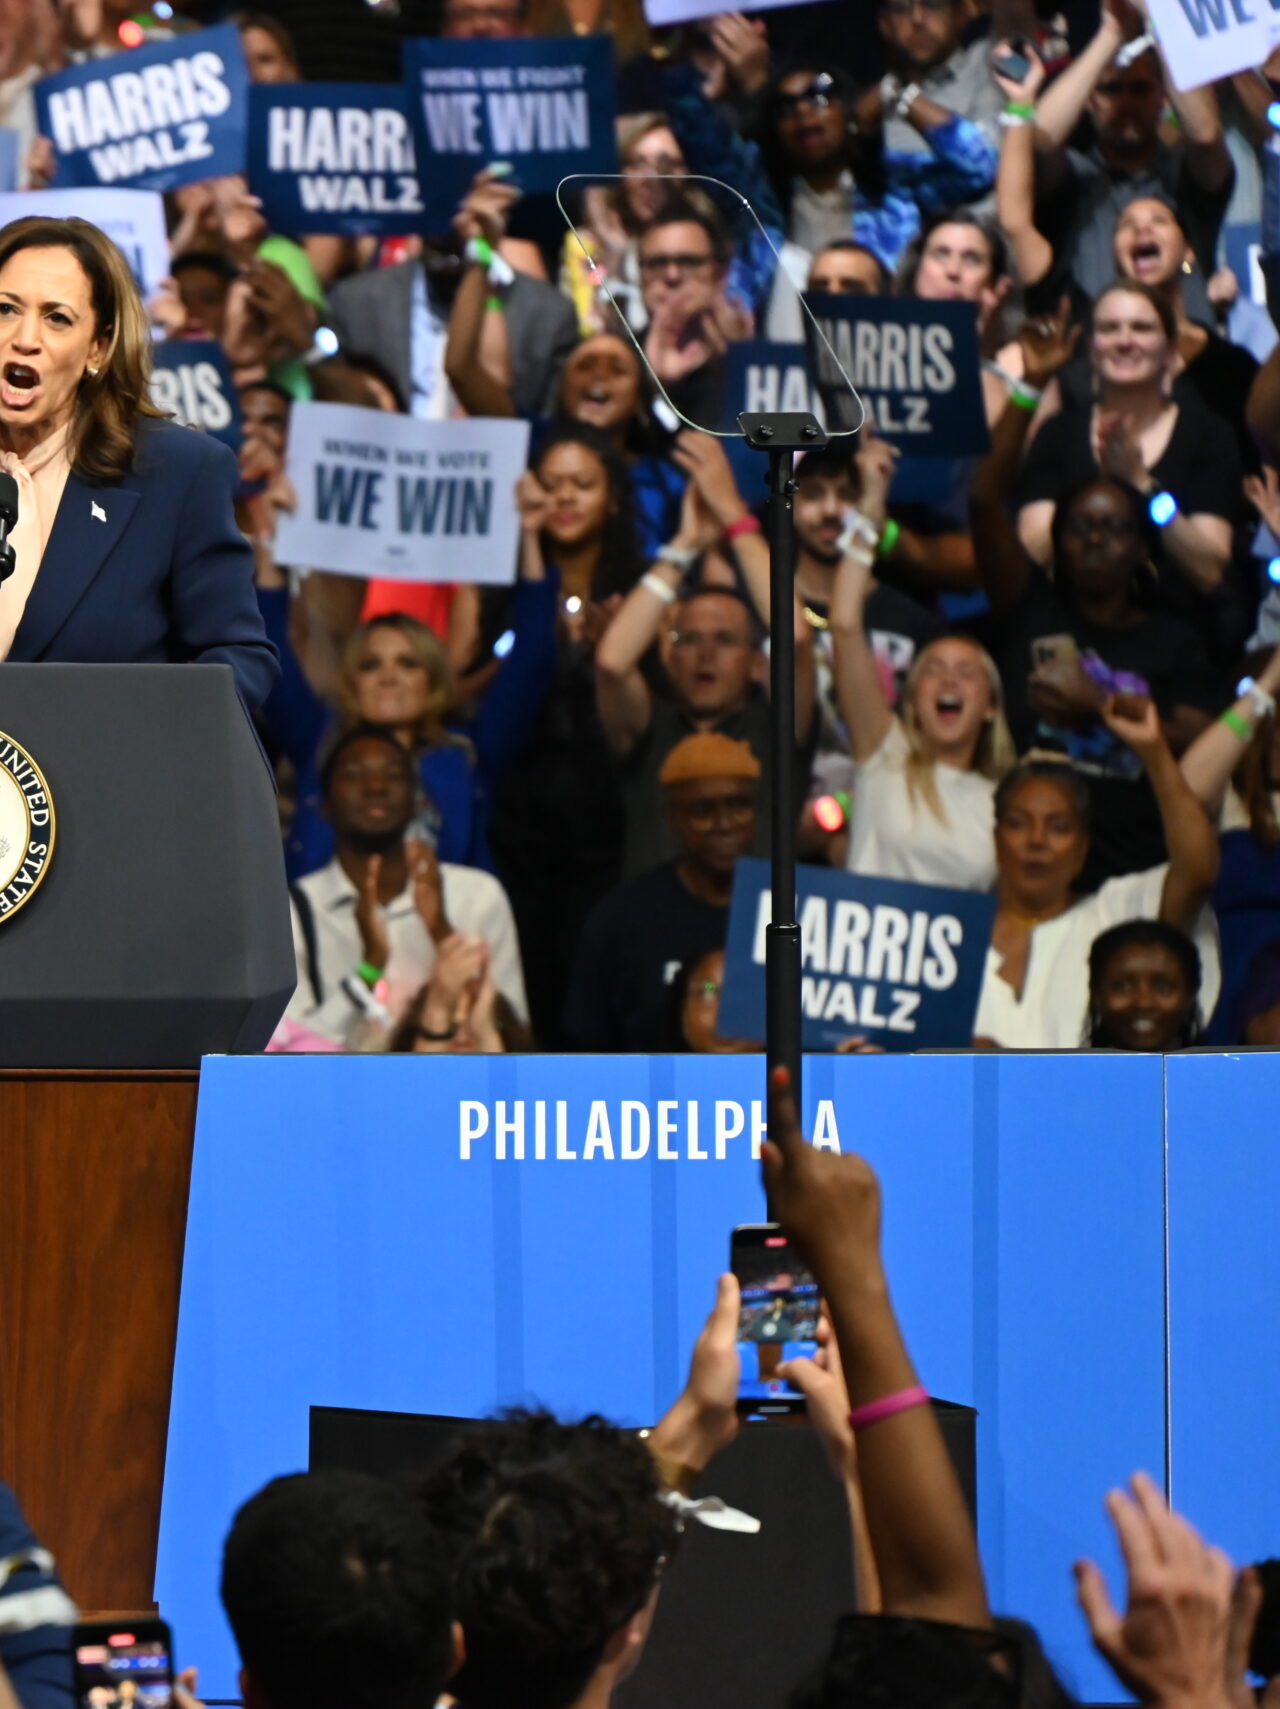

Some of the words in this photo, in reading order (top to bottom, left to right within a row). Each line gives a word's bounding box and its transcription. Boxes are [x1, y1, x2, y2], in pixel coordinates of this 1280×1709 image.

[48, 51, 232, 154] HARRIS
[422, 92, 483, 155] WE
[486, 88, 589, 154] WIN
[89, 120, 214, 183] WALZ
[268, 106, 417, 173] HARR
[297, 174, 425, 213] WALZ
[394, 450, 428, 469] WE
[313, 462, 384, 531] WE
[396, 475, 494, 537] WIN
